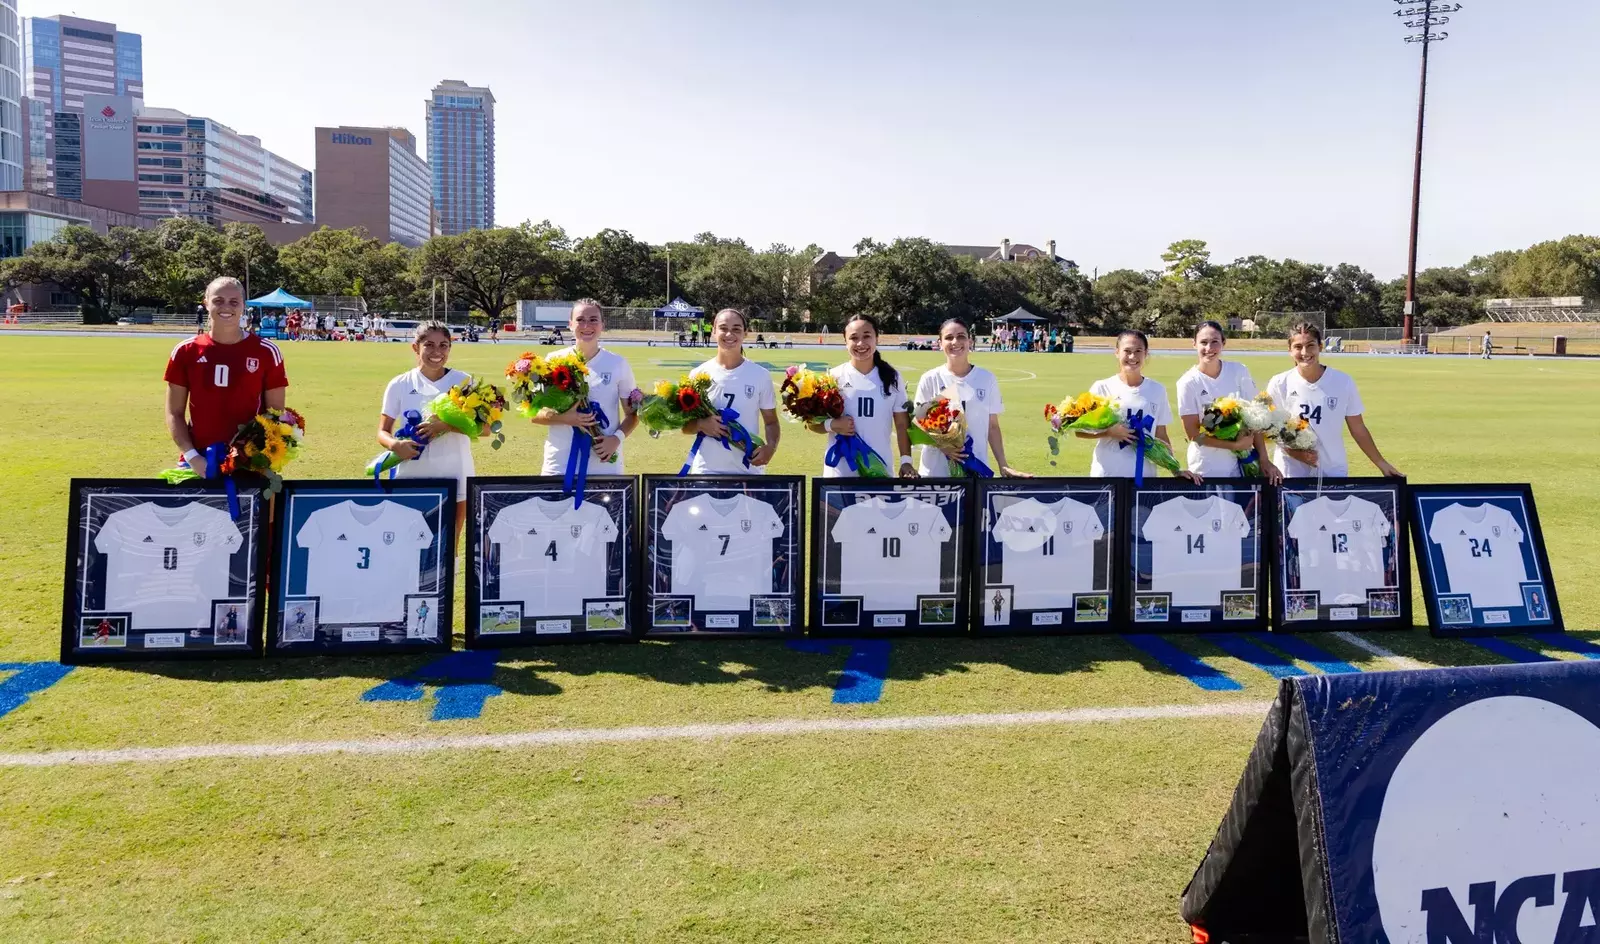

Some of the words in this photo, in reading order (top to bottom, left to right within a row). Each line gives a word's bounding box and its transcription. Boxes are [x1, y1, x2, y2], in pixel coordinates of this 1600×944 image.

[332, 132, 372, 145] Hilton
[214, 364, 229, 387] 0
[723, 393, 735, 408] 7
[858, 397, 874, 417] 10
[1299, 404, 1322, 424] 24
[544, 540, 558, 561] 4
[718, 535, 730, 556] 7
[882, 537, 901, 558] 10
[1043, 535, 1054, 556] 11
[1187, 533, 1205, 554] 14
[1469, 538, 1492, 557] 24
[163, 547, 177, 570] 0
[356, 547, 370, 569] 3
